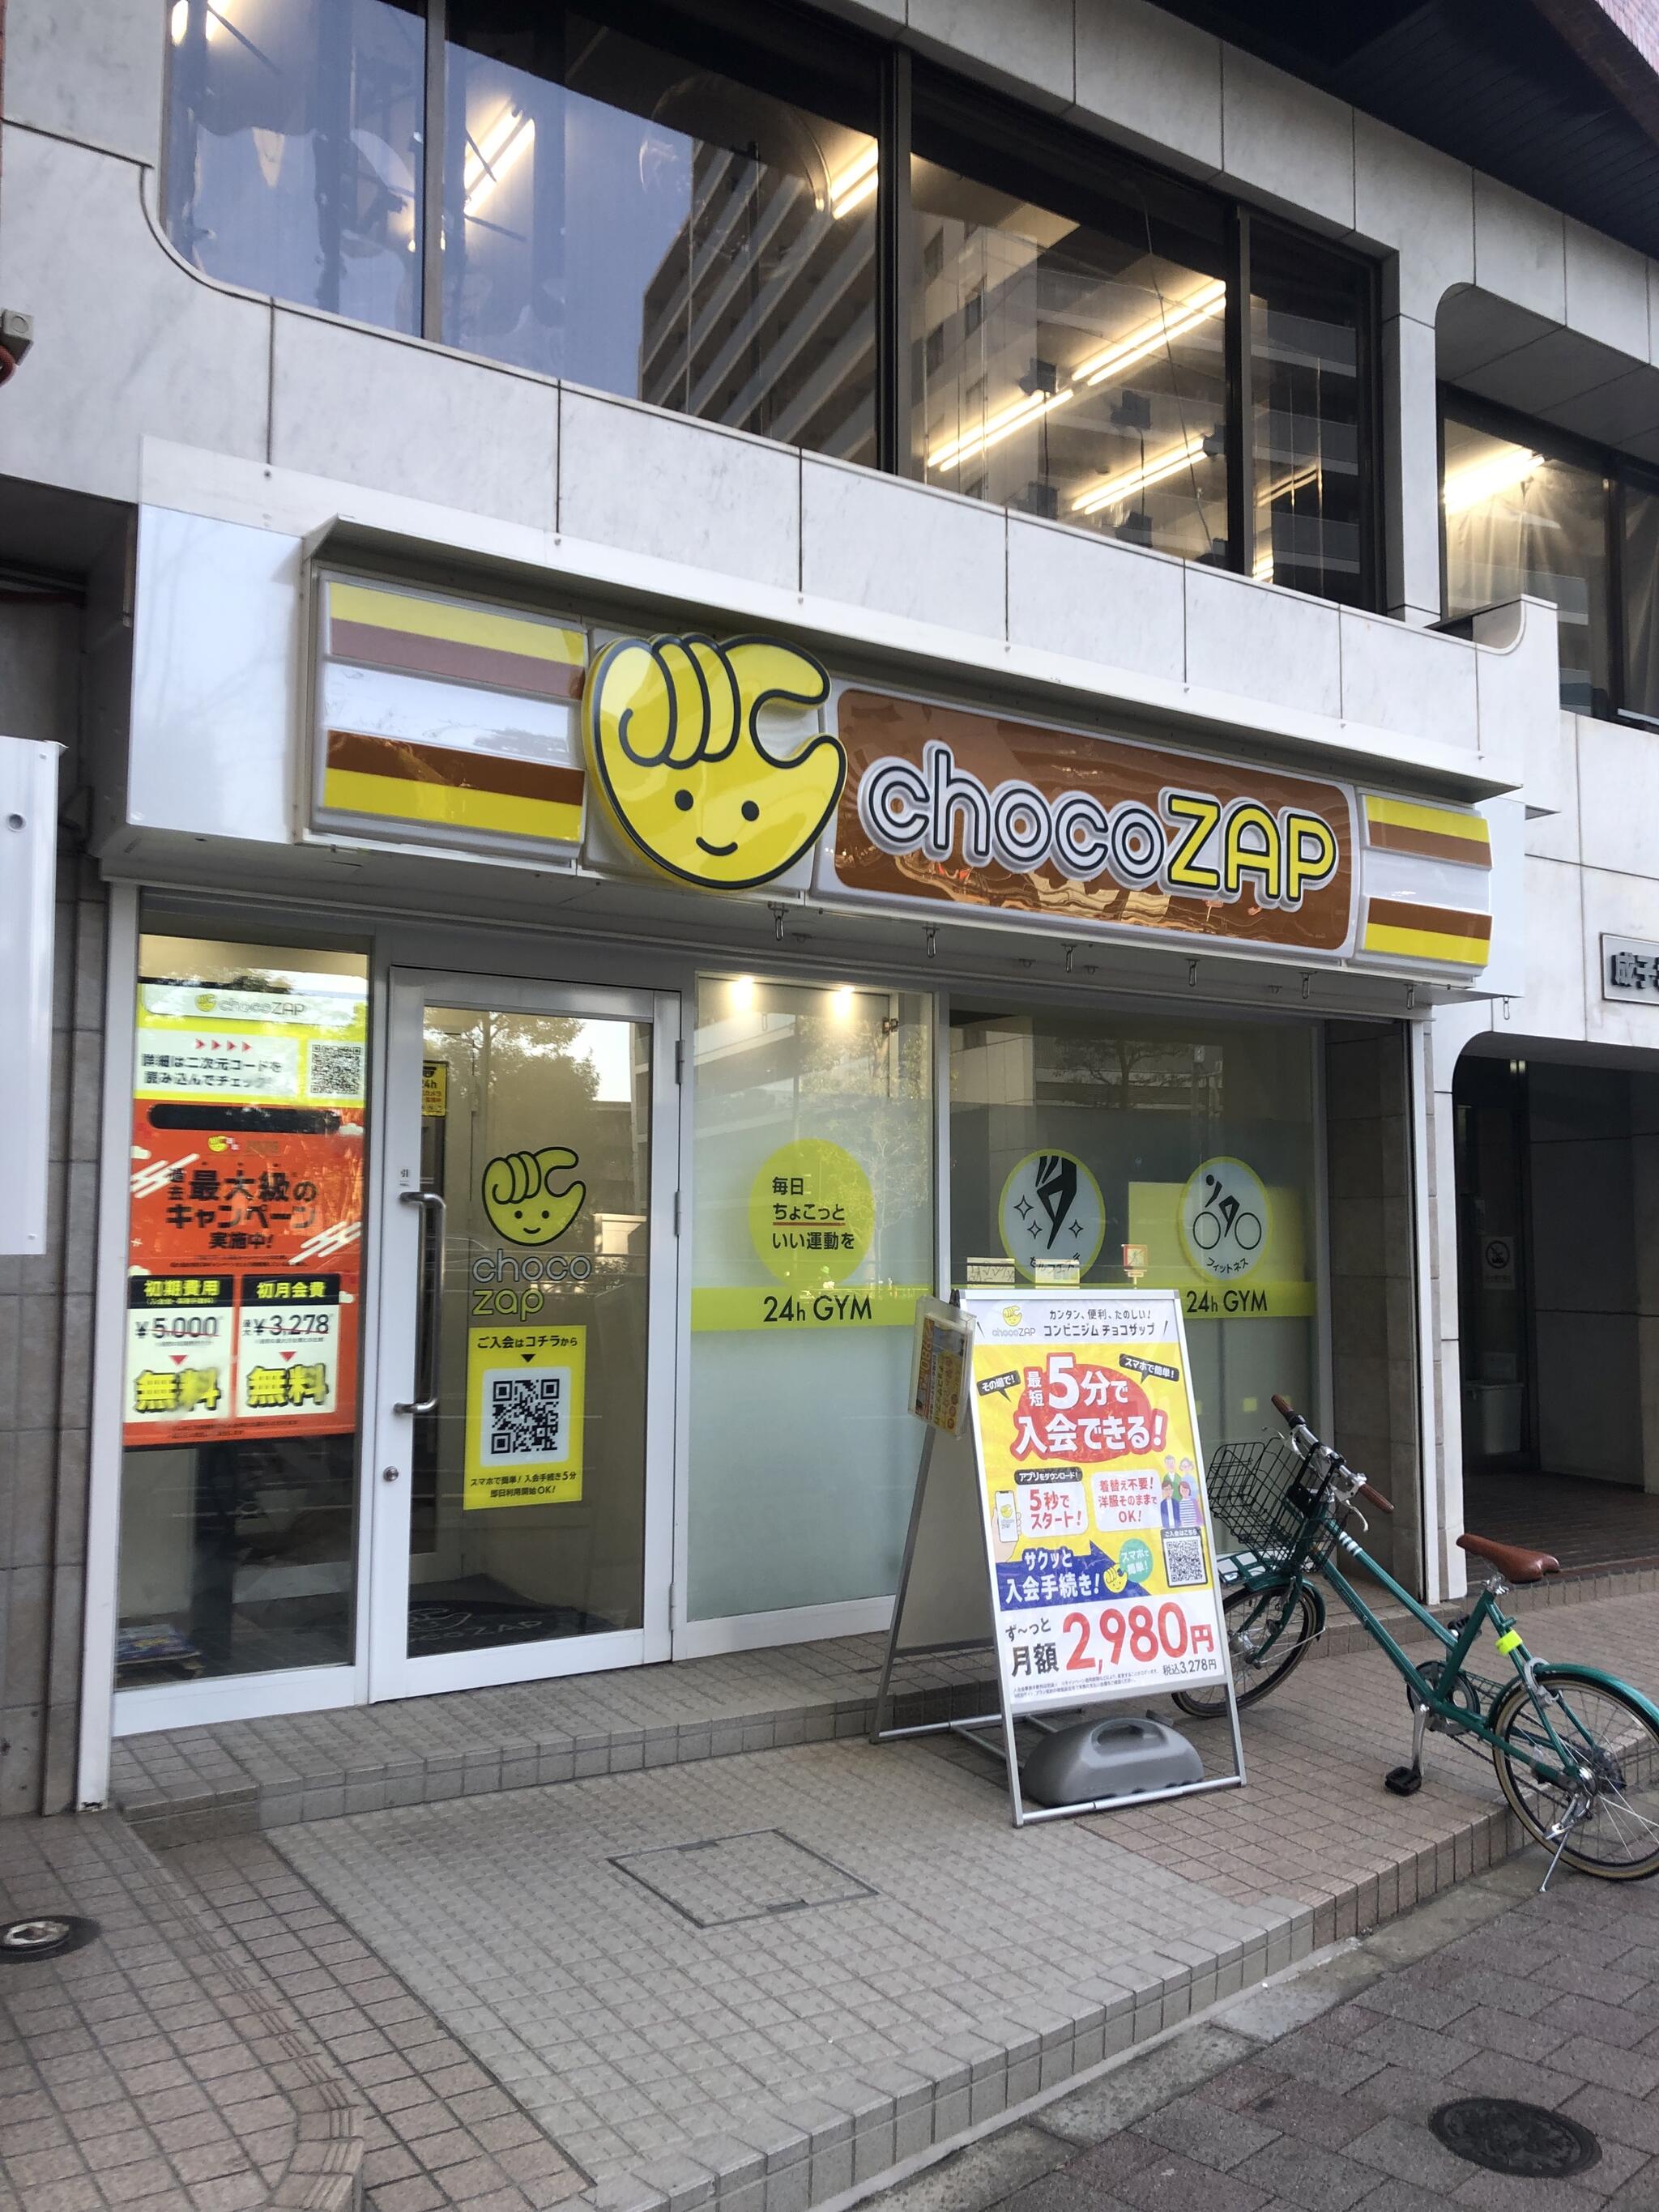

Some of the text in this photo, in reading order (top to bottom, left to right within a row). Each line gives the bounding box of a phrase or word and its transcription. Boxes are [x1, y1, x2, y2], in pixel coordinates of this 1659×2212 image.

[859, 740, 1338, 910] chocoZAP
[772, 1177, 804, 1196] 毎日
[166, 1204, 316, 1229] キャンペーン
[773, 1203, 845, 1221] ちょこっと
[772, 1232, 855, 1250] いい運動を
[472, 1248, 591, 1283] choco
[1206, 1257, 1249, 1274] フィットネス
[143, 1280, 220, 1297] 初期費用
[256, 1281, 326, 1298] 初月会費
[472, 1287, 544, 1322] zap
[764, 1295, 872, 1322] 24h GYM
[1187, 1290, 1267, 1313] 24h GYM
[1044, 1323, 1154, 1336] コンビニジム チョコザップ
[477, 1336, 578, 1349] ご入会はコチラから
[246, 1363, 329, 1409] 無料
[1014, 1413, 1163, 1455] 入会できる!
[1099, 1477, 1154, 1493] 着替え不要!
[1030, 1489, 1069, 1511] 5秒で
[1098, 1494, 1158, 1509] 洋服そのままで
[1030, 1511, 1081, 1530] スタート!
[1119, 1510, 1141, 1524] OK!
[1024, 1549, 1073, 1571] サクッと
[1005, 1573, 1100, 1605] 入会手続き!
[1010, 1600, 1215, 1677] 月額 2,980円
[1162, 1658, 1218, 1676] 税込3,278円
